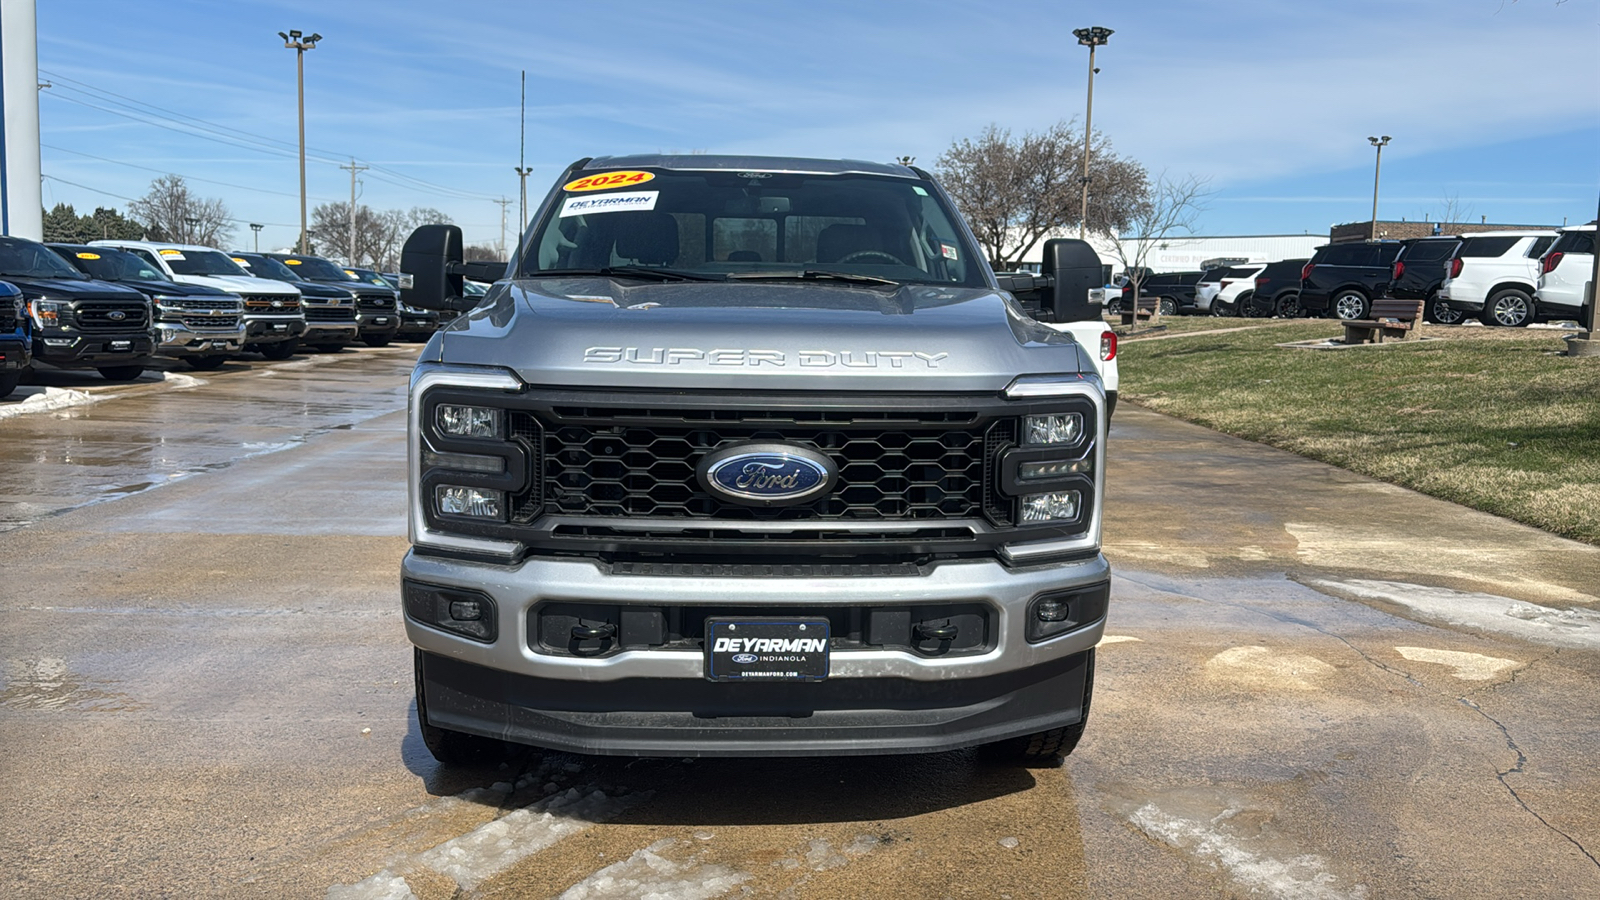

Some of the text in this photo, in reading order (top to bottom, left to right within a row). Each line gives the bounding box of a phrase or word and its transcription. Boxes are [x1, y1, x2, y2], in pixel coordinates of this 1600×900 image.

[572, 173, 645, 190] 2024
[569, 196, 652, 209] DEYARMAN
[583, 346, 948, 368] SUPER DUTY
[736, 462, 800, 488] Ford
[713, 638, 827, 652] DEYARMAN
[737, 654, 753, 662] Ford
